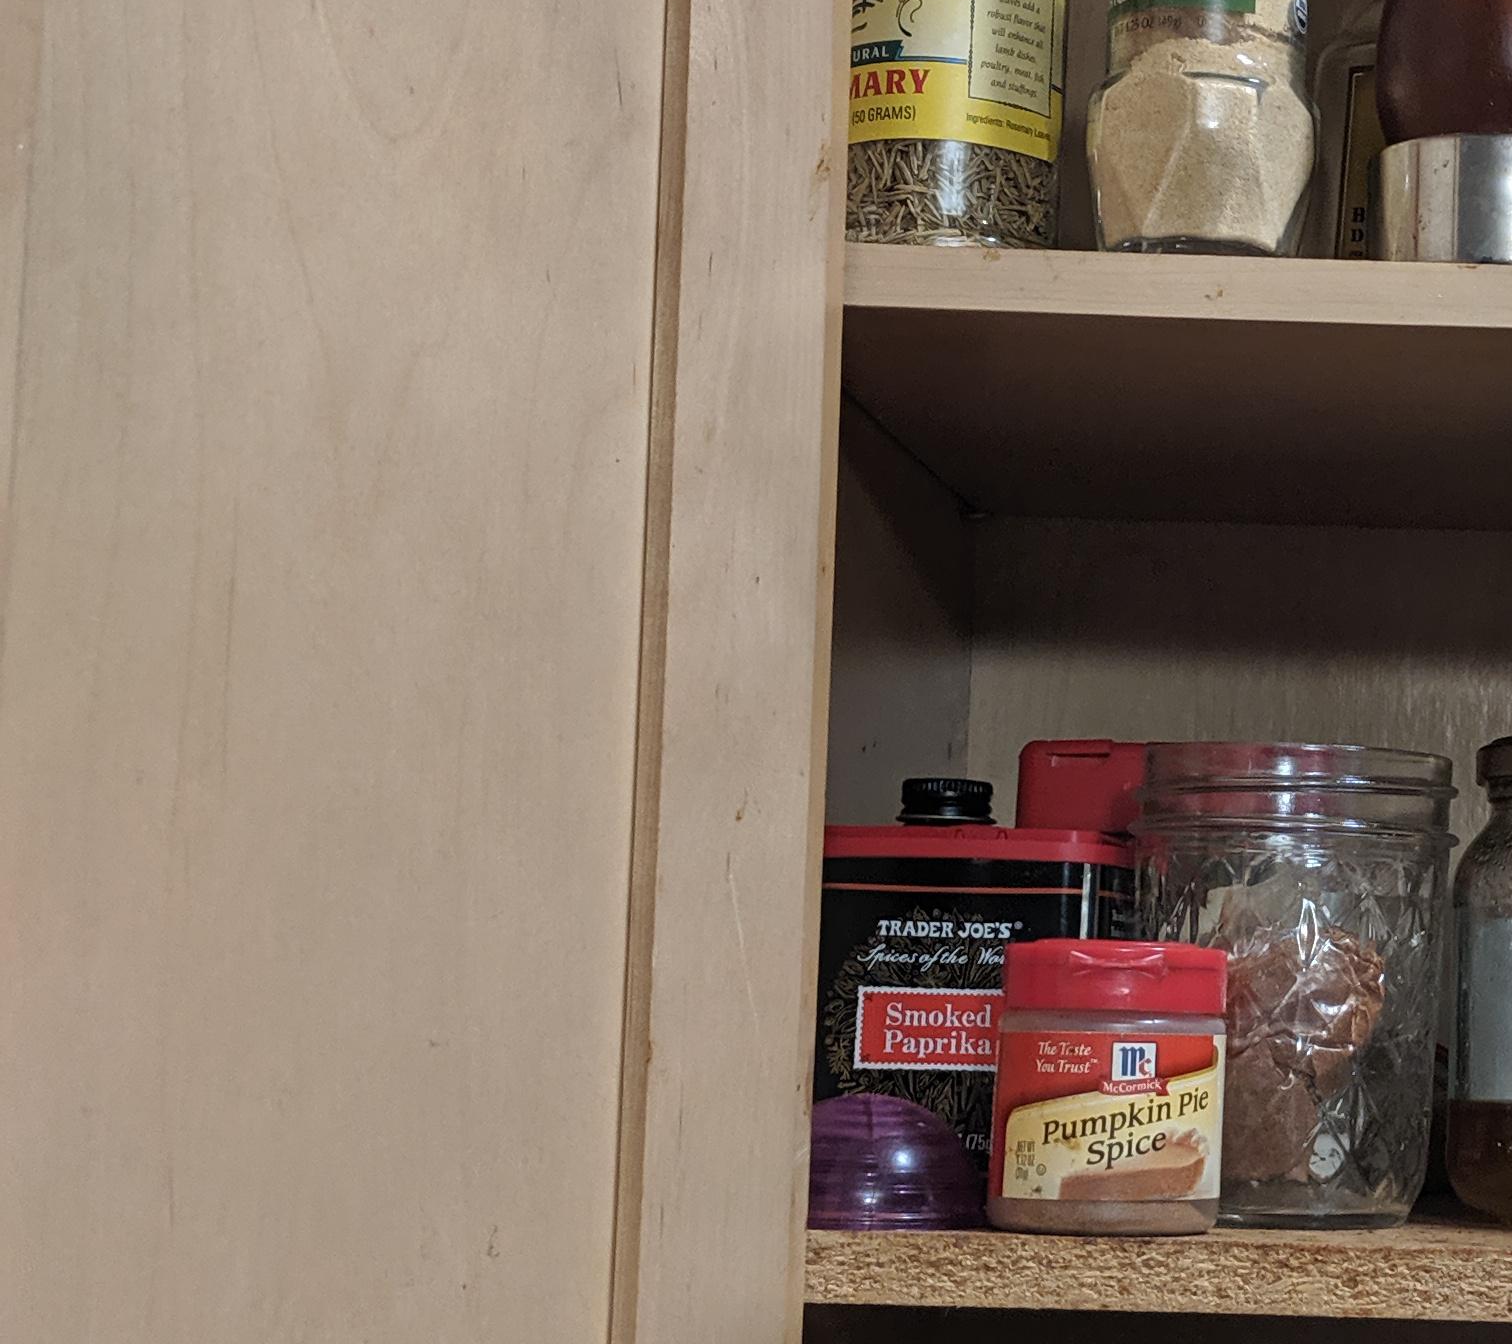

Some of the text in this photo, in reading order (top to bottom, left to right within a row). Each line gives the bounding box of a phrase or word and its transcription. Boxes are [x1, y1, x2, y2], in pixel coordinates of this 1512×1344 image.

[868, 105, 916, 122] GRAMS)
[878, 919, 1013, 939] TRADER JOE'S
[857, 942, 919, 971] Spices
[918, 946, 944, 972] of
[940, 946, 968, 965] the
[886, 1002, 992, 1028] Smoked
[883, 1029, 992, 1059] Paprika
[1038, 1041, 1057, 1056] The
[1035, 1058, 1055, 1073] You
[1103, 1079, 1162, 1094] McCormick
[1042, 1087, 1209, 1145] Pumpkin Pie
[1086, 1131, 1167, 1170] Spice
